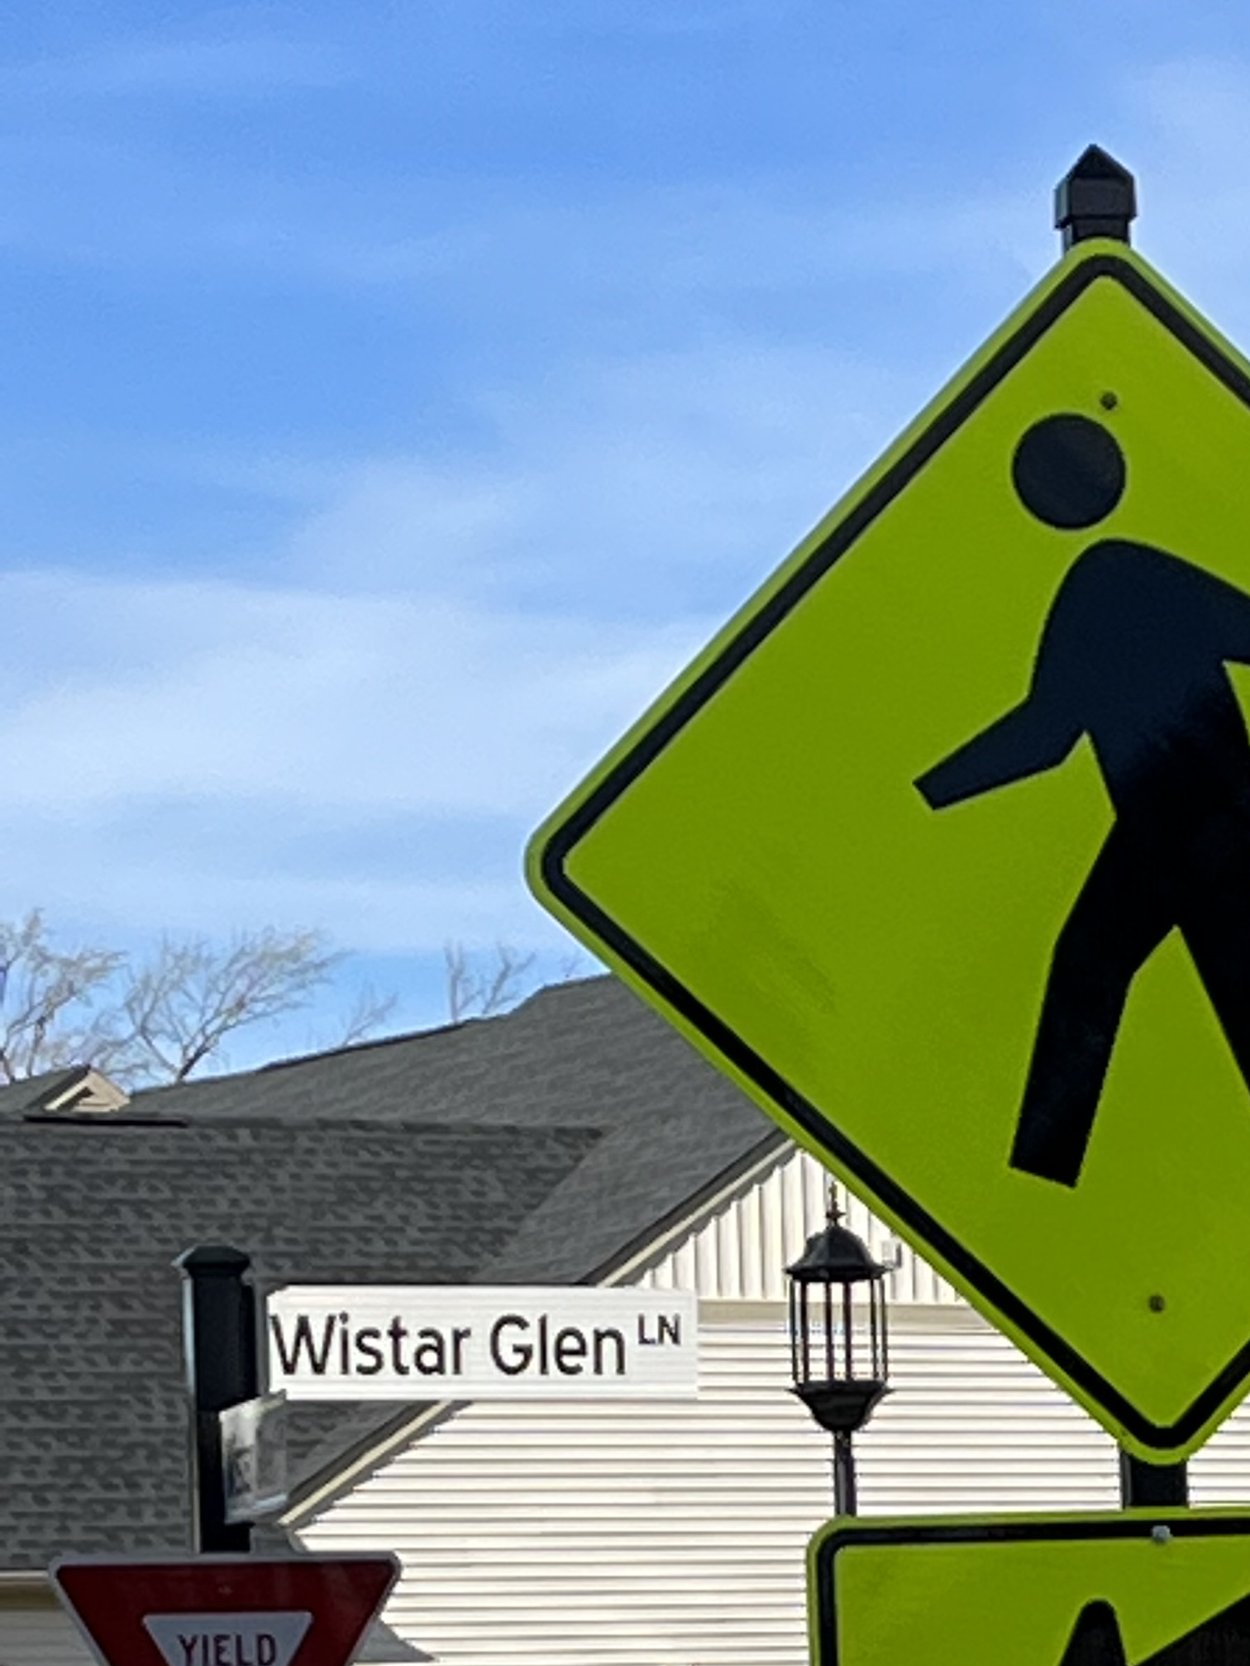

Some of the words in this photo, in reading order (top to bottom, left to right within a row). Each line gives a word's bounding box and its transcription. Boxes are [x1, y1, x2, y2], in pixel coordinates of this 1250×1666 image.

[270, 1312, 471, 1376] Wistar
[489, 1313, 626, 1376] Glen
[638, 1314, 681, 1345] LN
